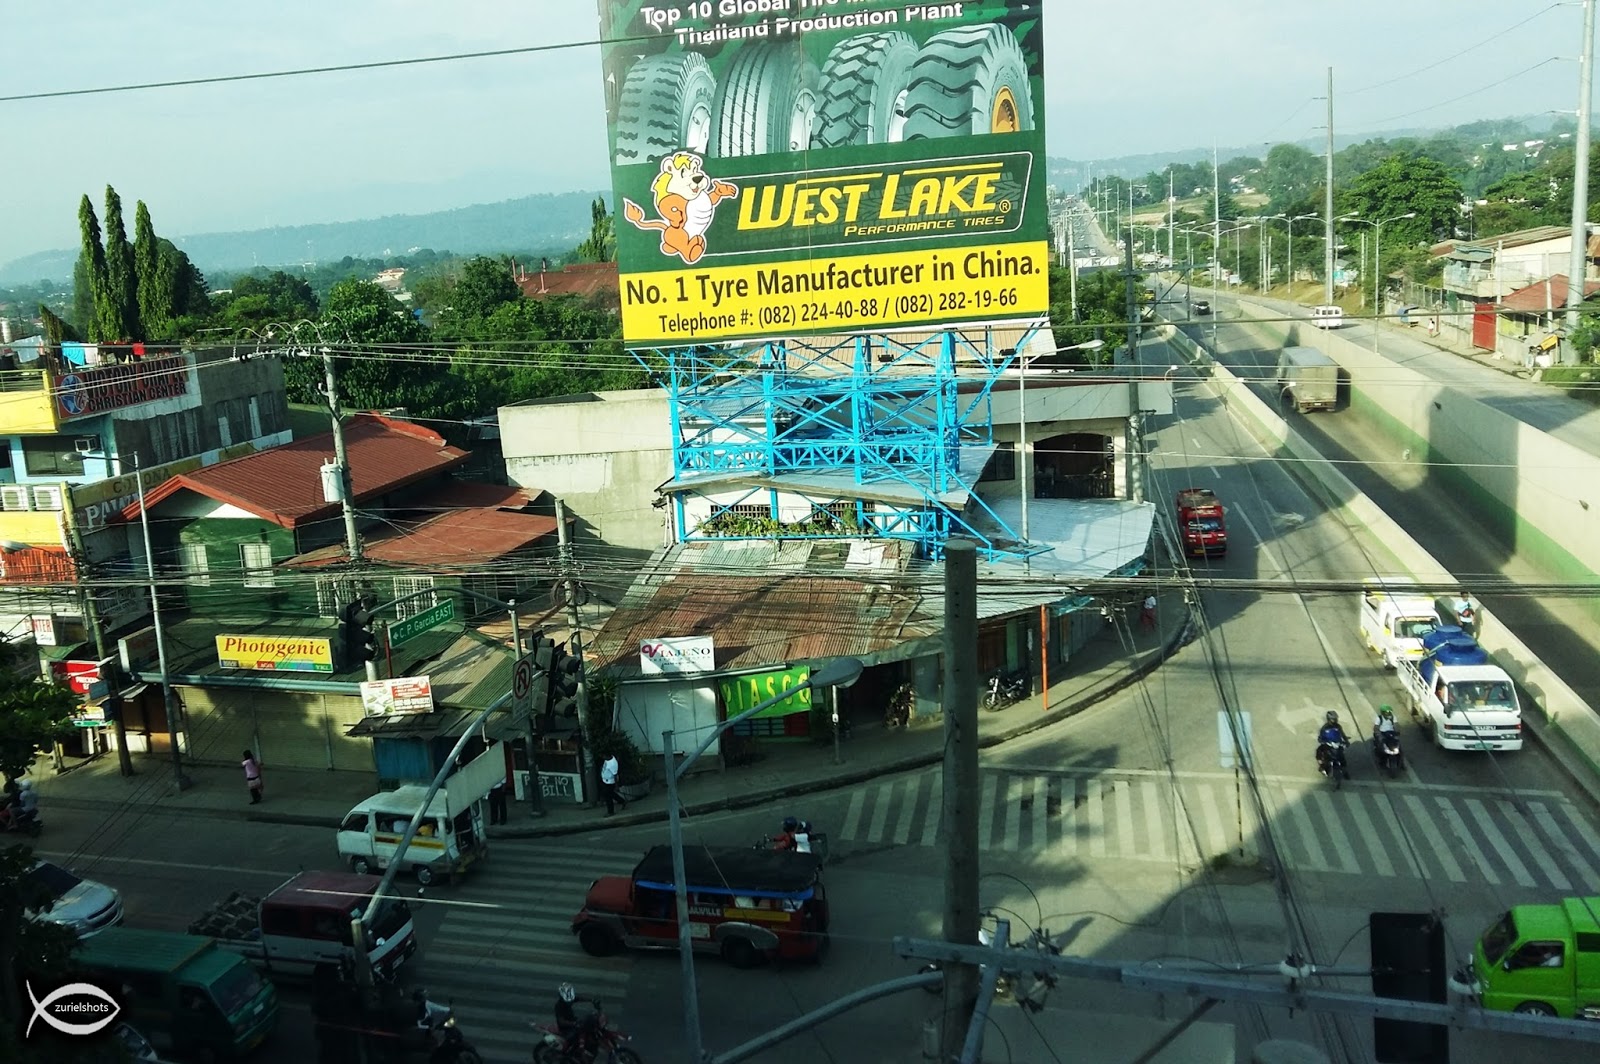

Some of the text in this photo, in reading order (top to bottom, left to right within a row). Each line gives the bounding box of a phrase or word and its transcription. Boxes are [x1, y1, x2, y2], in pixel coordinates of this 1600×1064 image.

[640, 6, 681, 25] Top
[687, 1, 712, 19] 10
[719, 0, 790, 15] Global
[674, 3, 963, 45] Thailand Production Plant
[737, 170, 1001, 231] WEST LAKE
[844, 215, 1005, 237] PERFORMANCE TIRES
[626, 250, 1040, 307] No. 1 Tyre Manufacturer in China.
[659, 287, 1017, 336] Telephone #: (082) 224-40-88 / (082) 282-19-66
[89, 382, 187, 411] CHRISTIAN CENTER
[414, 615, 435, 631] Garcia
[435, 604, 451, 621] EAST
[224, 637, 325, 657] Photogenic
[641, 643, 711, 658] VIAJEÑO
[722, 673, 811, 712] PIASCO
[524, 775, 569, 786] PST NO
[542, 784, 571, 797] BILL
